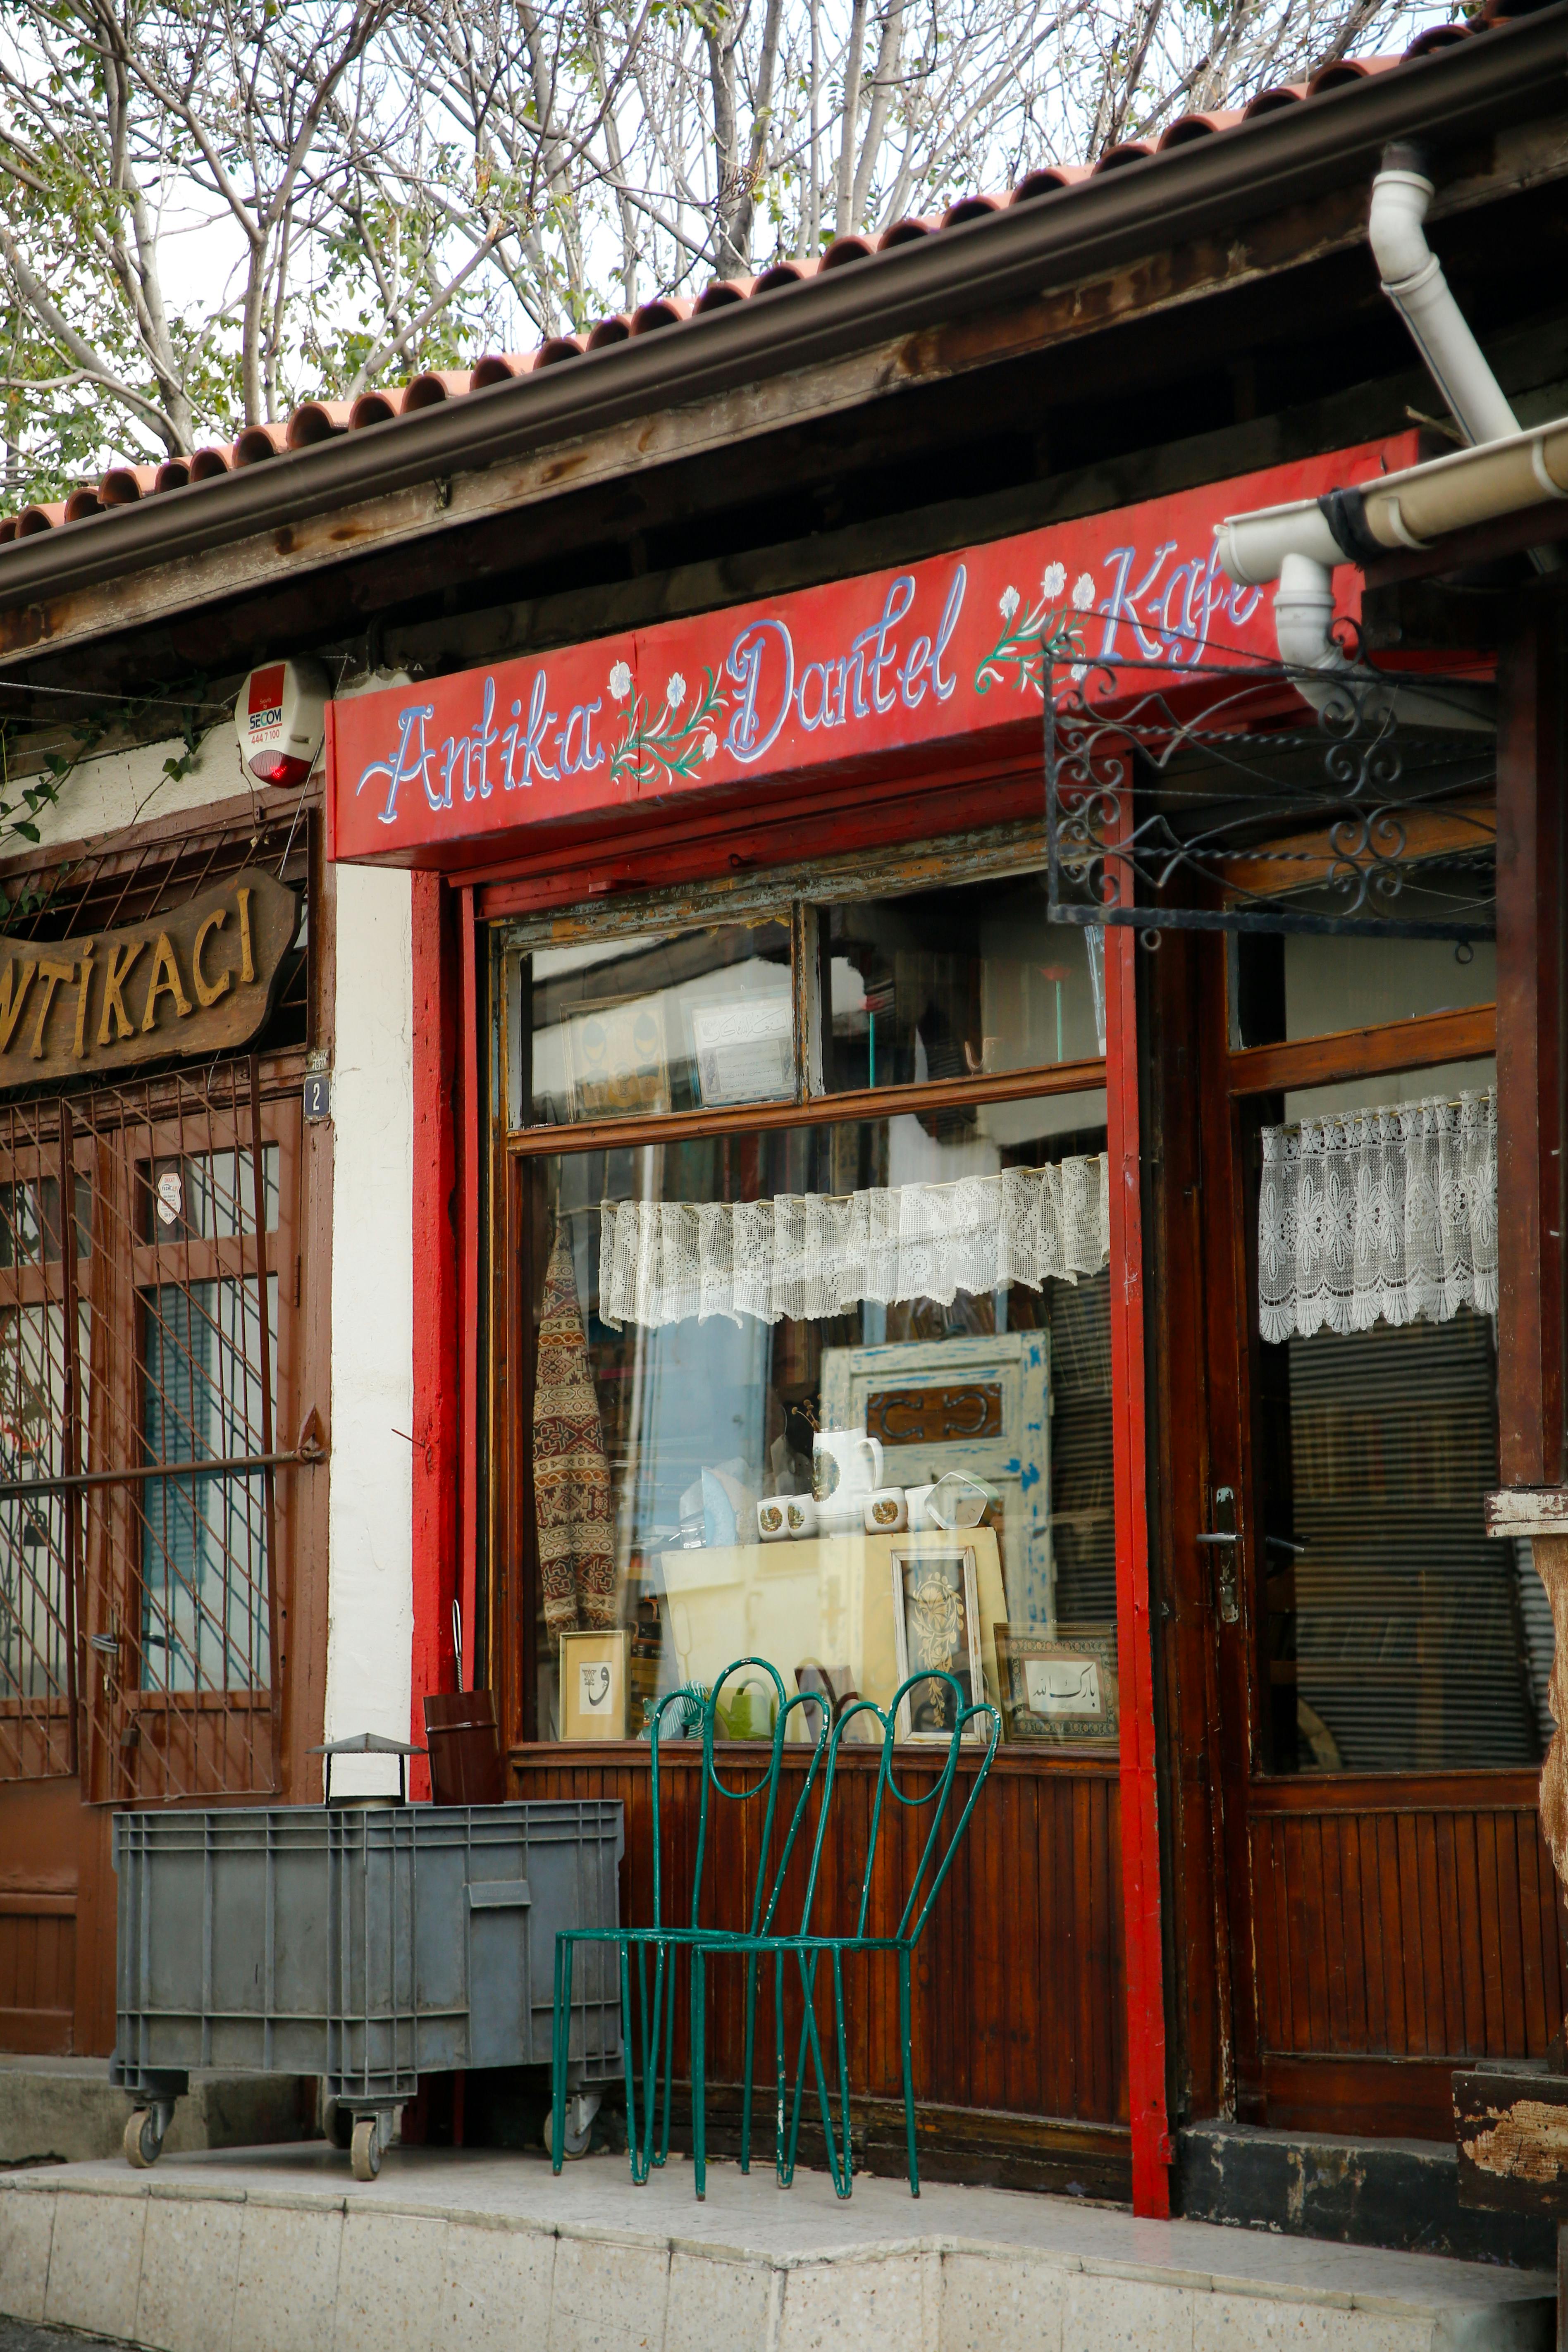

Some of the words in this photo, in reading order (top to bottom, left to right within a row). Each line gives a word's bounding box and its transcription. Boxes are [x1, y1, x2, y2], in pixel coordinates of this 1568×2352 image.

[356, 669, 605, 823] Antika
[725, 564, 967, 763] Dantel
[1098, 536, 1264, 673] Kafe
[250, 708, 282, 730] SECOM
[251, 733, 263, 744] 444
[265, 731, 268, 741] 7
[270, 729, 280, 739] 100
[313, 1083, 320, 1111] 2
